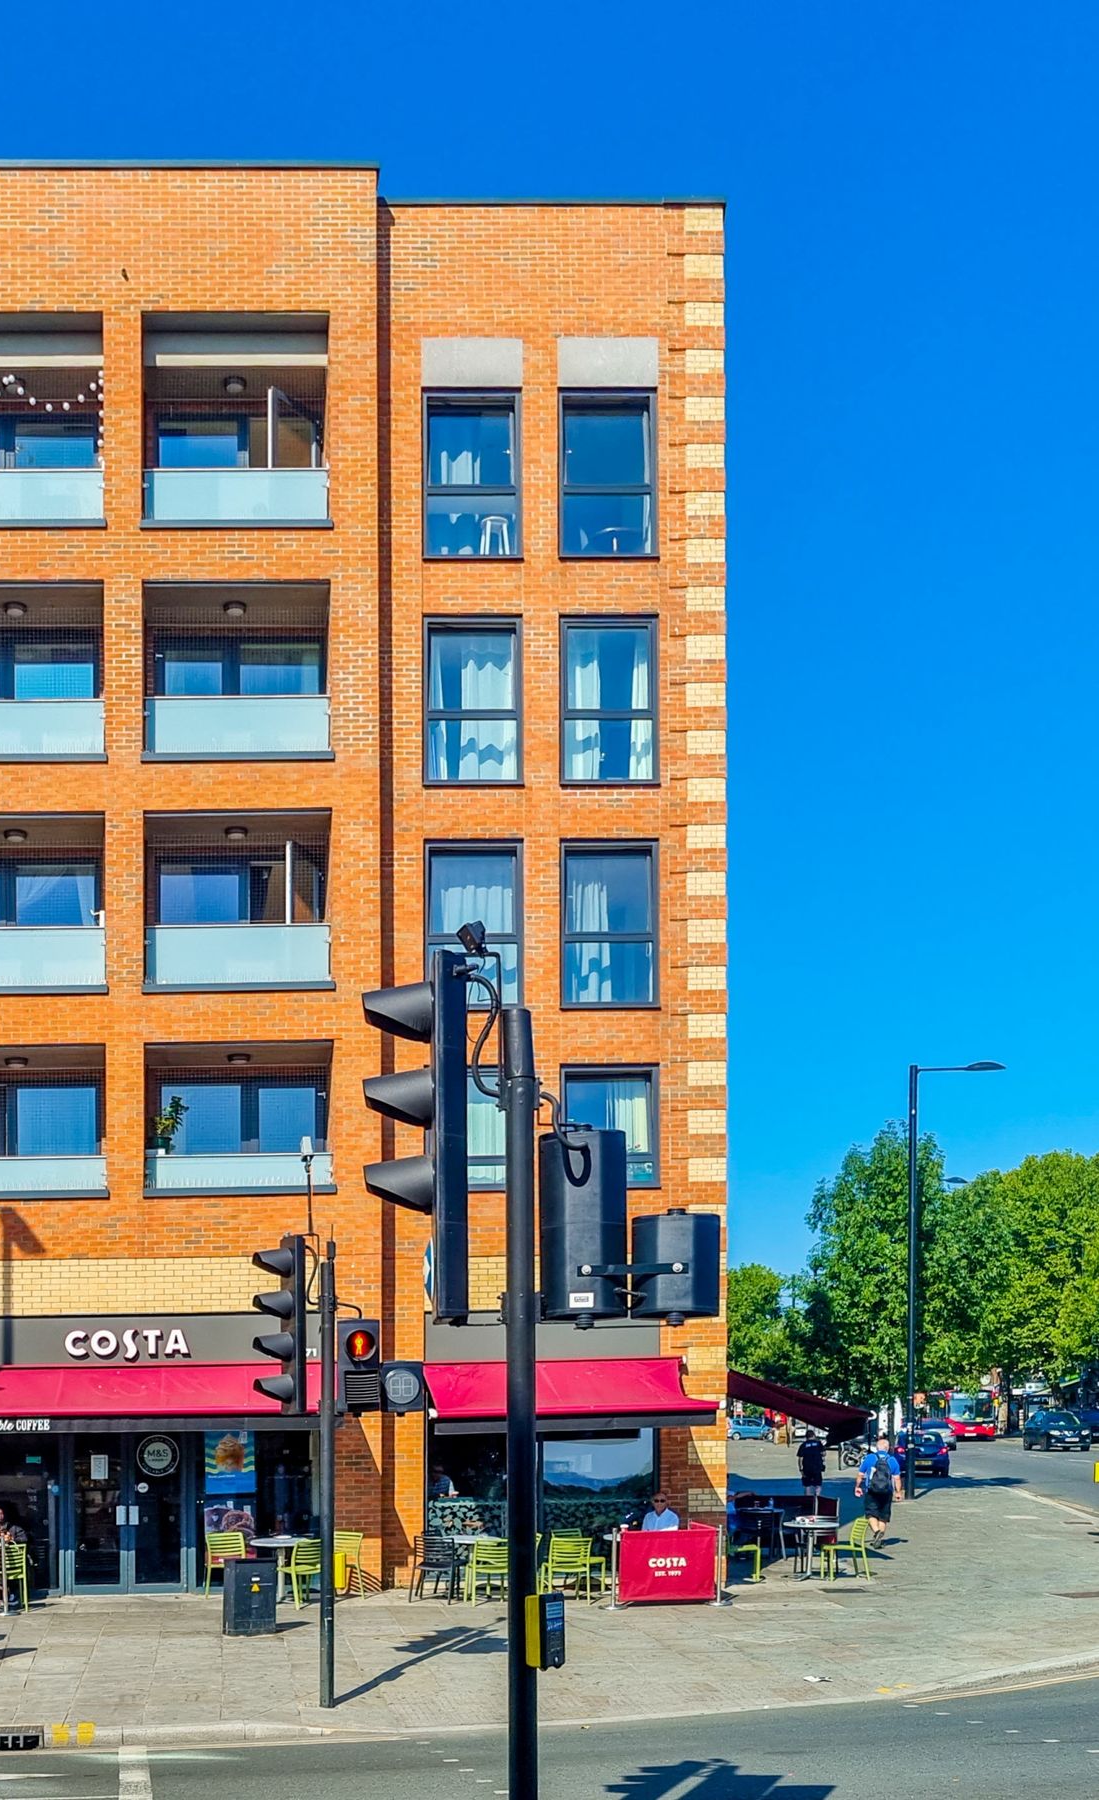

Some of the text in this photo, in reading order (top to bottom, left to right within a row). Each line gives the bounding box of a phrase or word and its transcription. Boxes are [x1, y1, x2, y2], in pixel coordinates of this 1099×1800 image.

[64, 1328, 191, 1362] COSTA
[16, 1419, 51, 1431] COFFEE
[147, 1448, 169, 1458] M&S
[648, 1557, 687, 1568] COSTA
